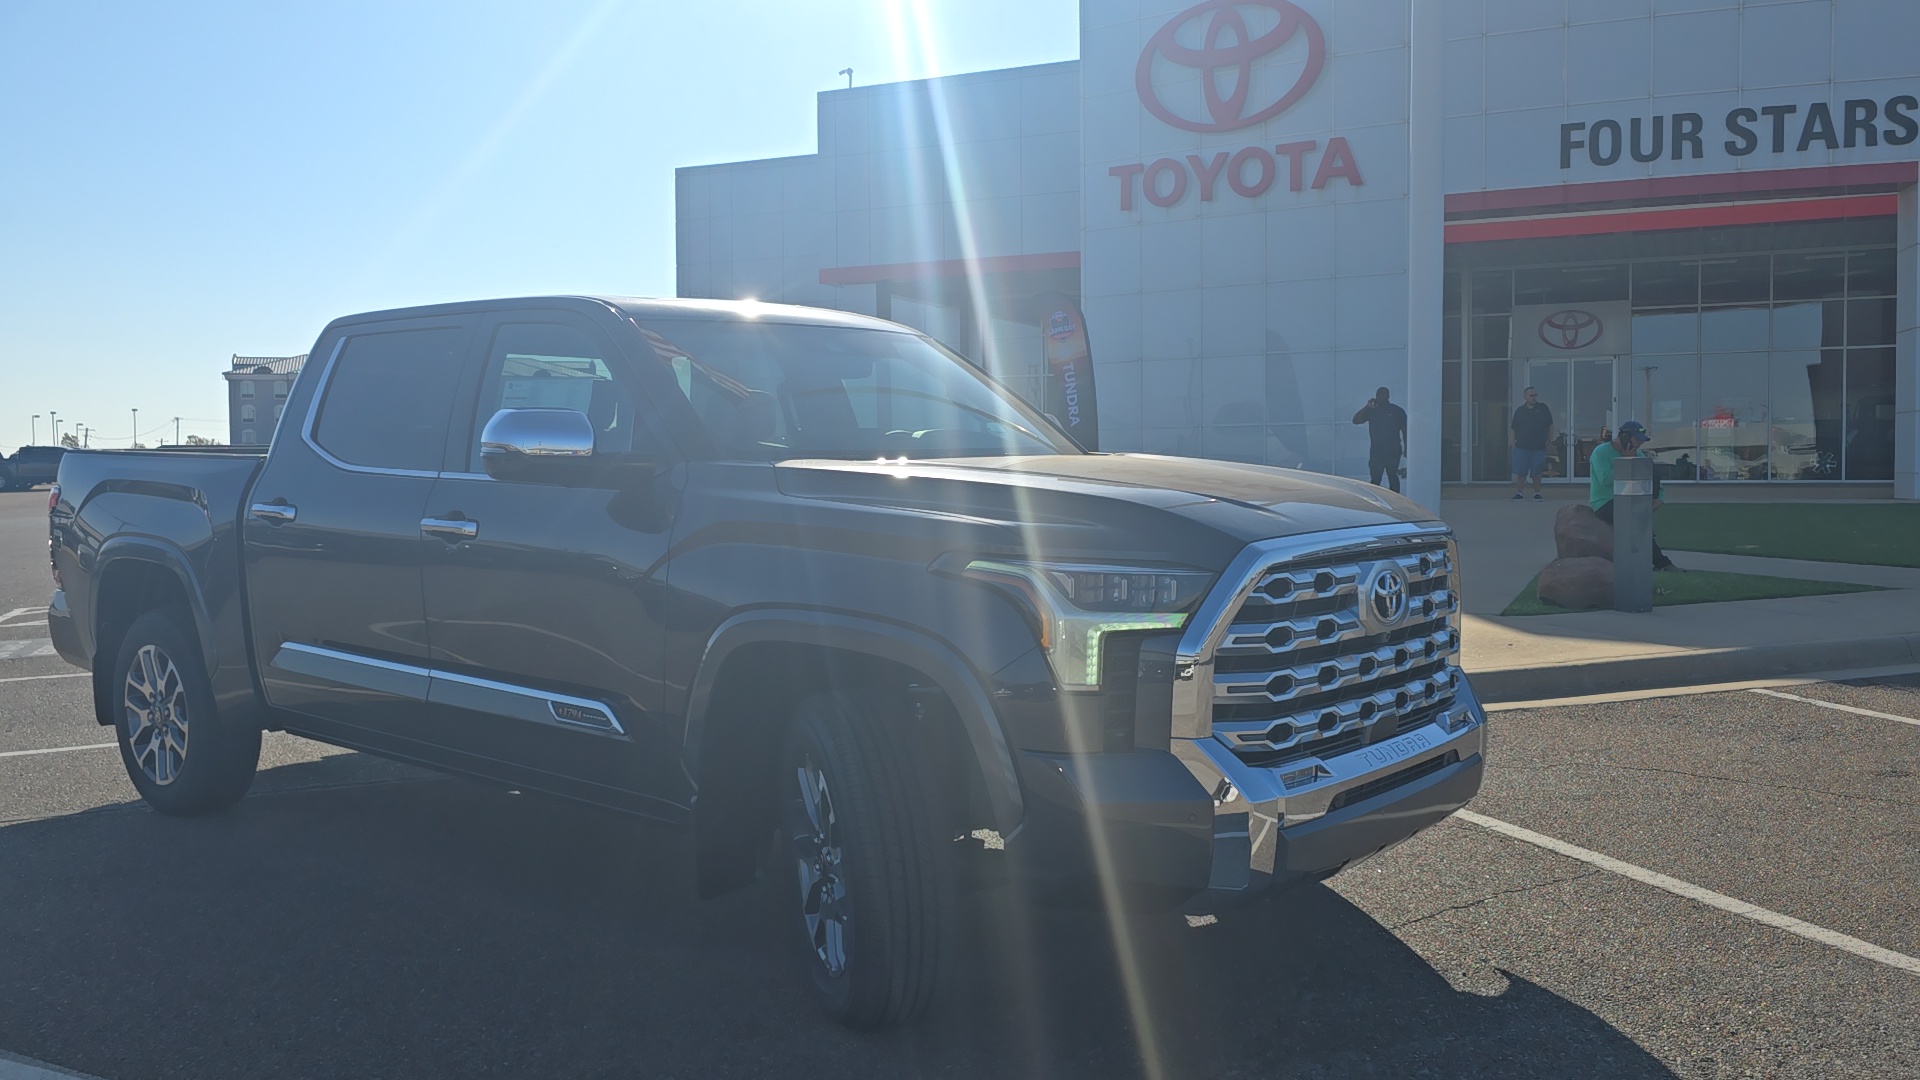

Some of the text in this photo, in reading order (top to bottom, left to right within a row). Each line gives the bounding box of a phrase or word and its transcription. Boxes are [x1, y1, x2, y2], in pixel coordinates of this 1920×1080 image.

[1560, 95, 1919, 169] FOUR STARS
[1108, 136, 1364, 211] TOYOTA
[1062, 361, 1081, 427] TUNDRA
[1355, 733, 1432, 767] TUNDRA
